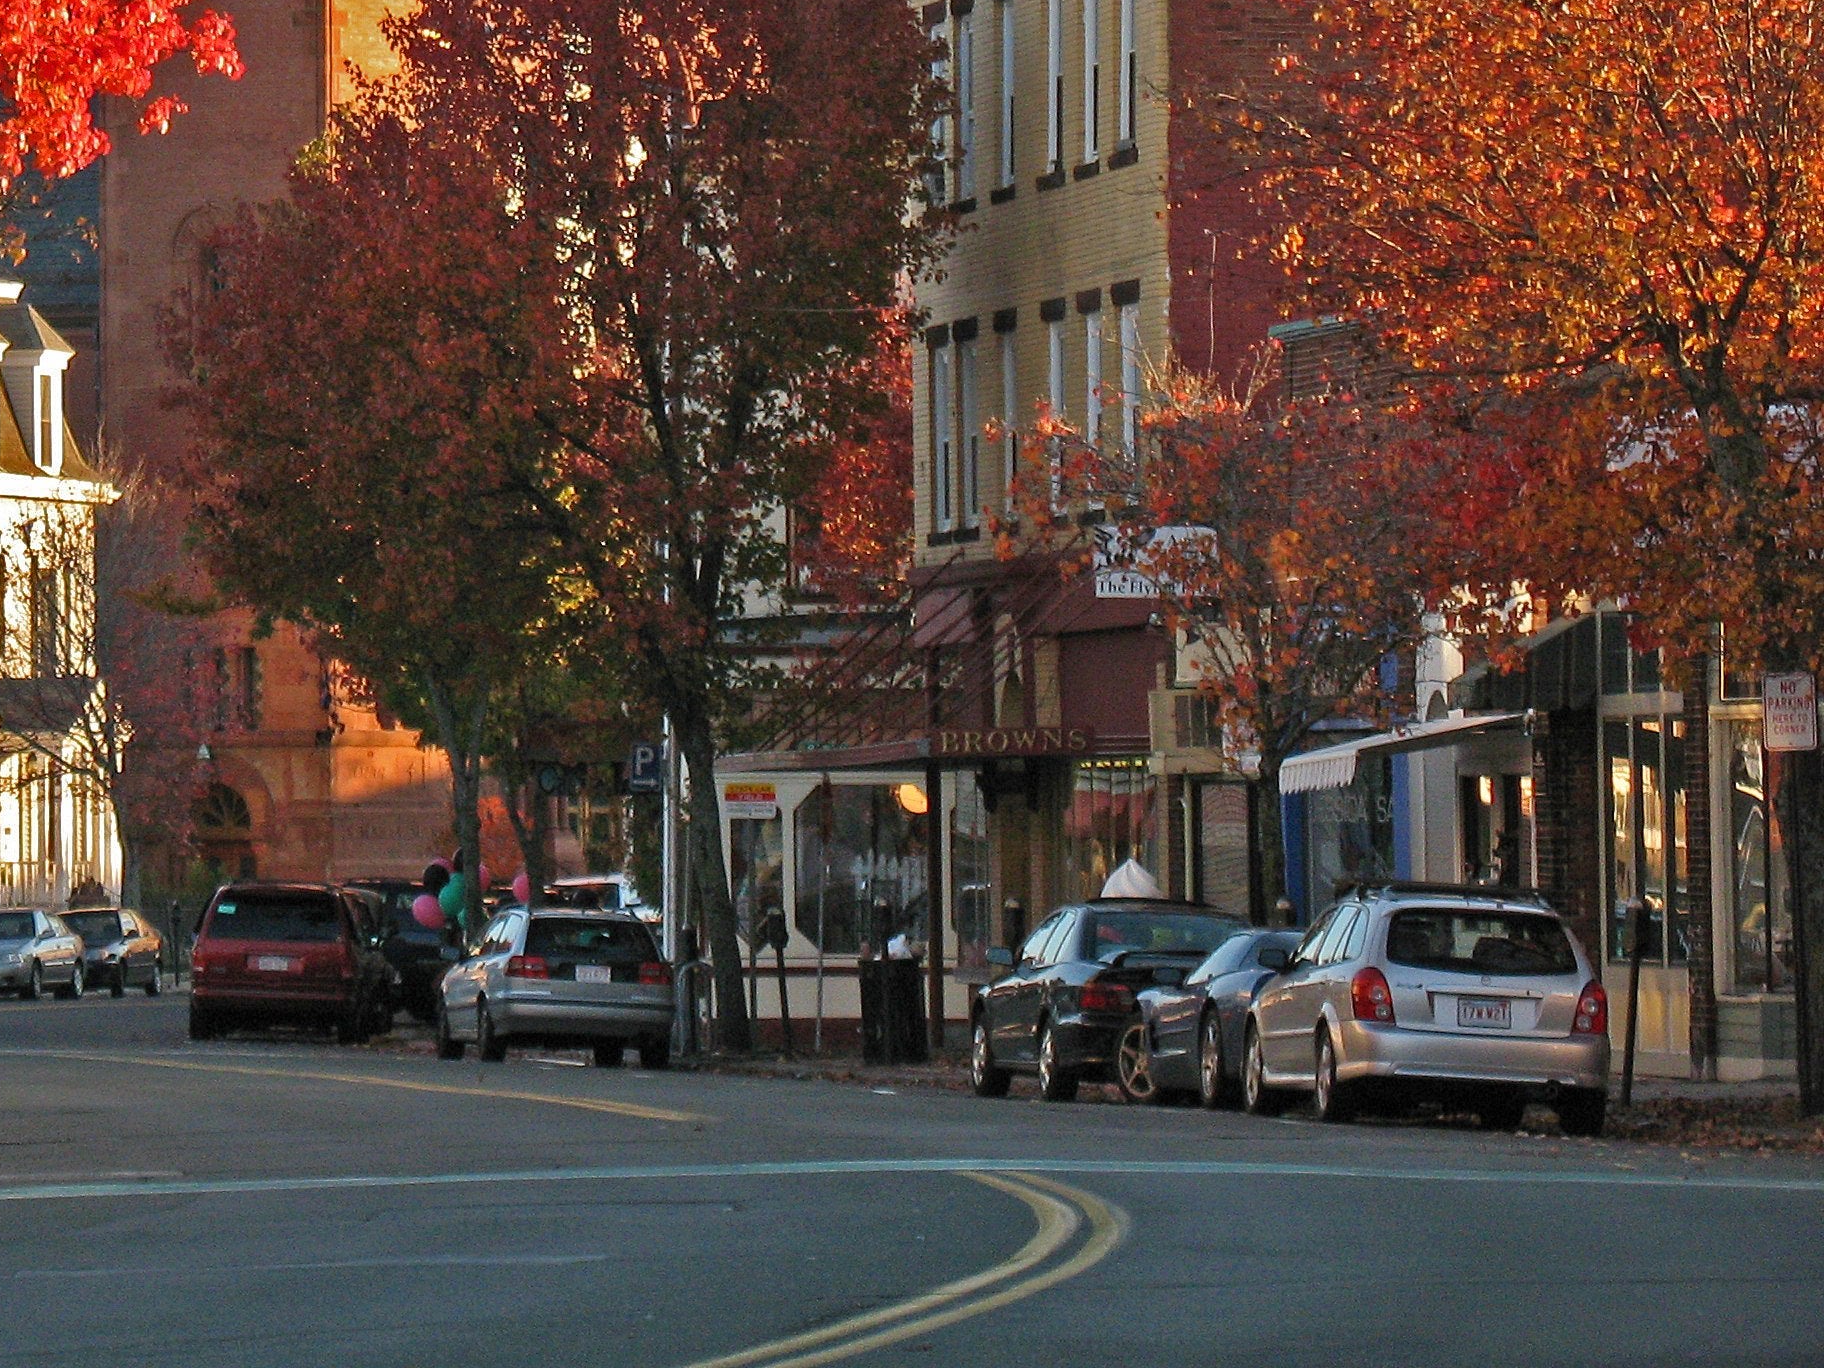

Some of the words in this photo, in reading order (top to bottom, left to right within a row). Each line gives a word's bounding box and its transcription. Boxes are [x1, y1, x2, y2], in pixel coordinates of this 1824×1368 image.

[1100, 580, 1126, 593] The
[1780, 680, 1796, 694] NO
[941, 729, 1087, 753] BROWNS
[635, 746, 655, 776] P
